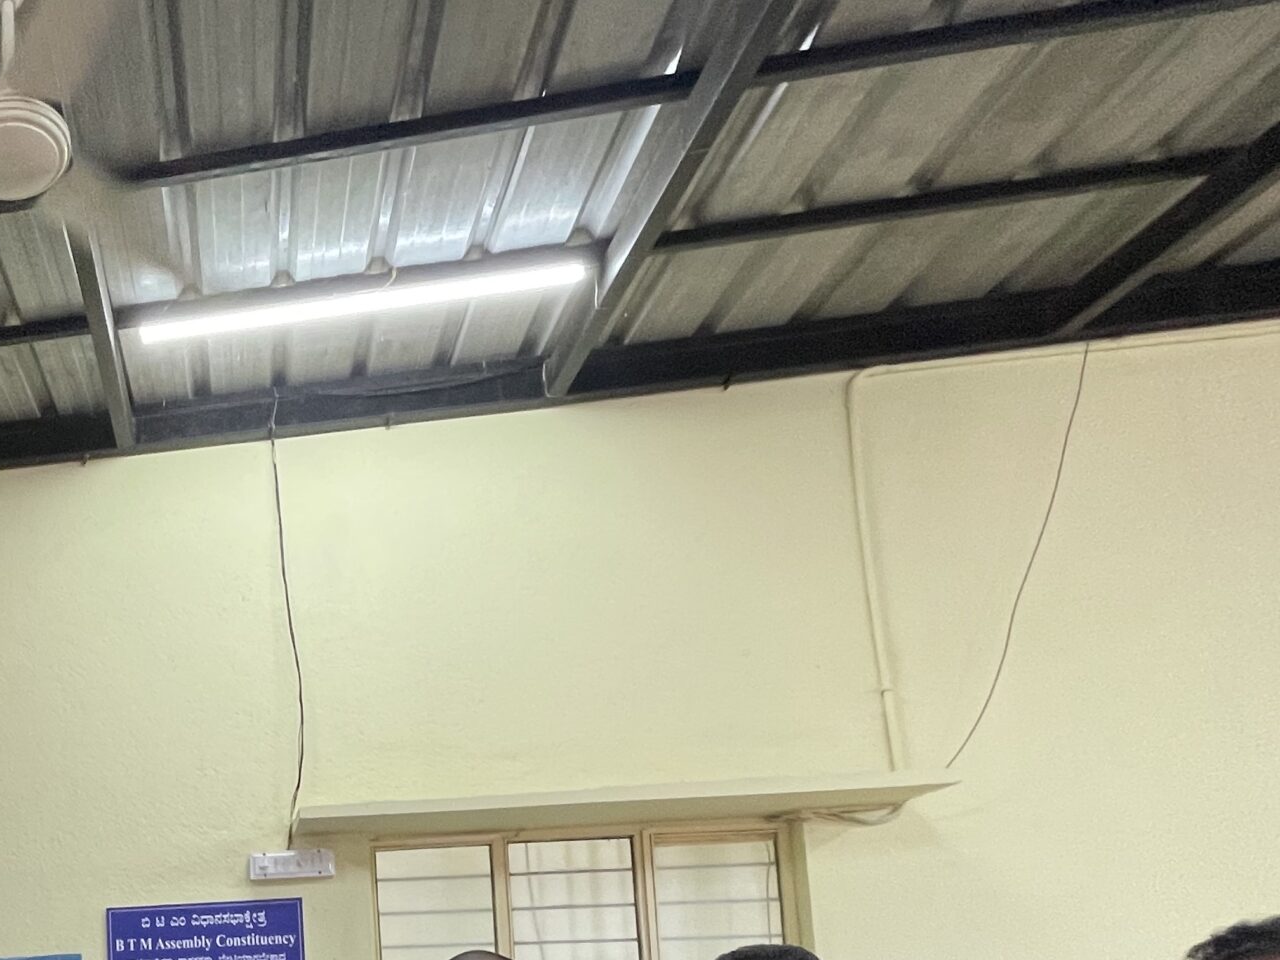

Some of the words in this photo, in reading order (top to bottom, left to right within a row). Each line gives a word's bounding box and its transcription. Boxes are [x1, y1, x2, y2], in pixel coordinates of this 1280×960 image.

[115, 939, 125, 952] B
[127, 938, 137, 951] T
[140, 937, 153, 951] M
[155, 935, 213, 952] Assembly
[216, 932, 297, 949] Constituency
